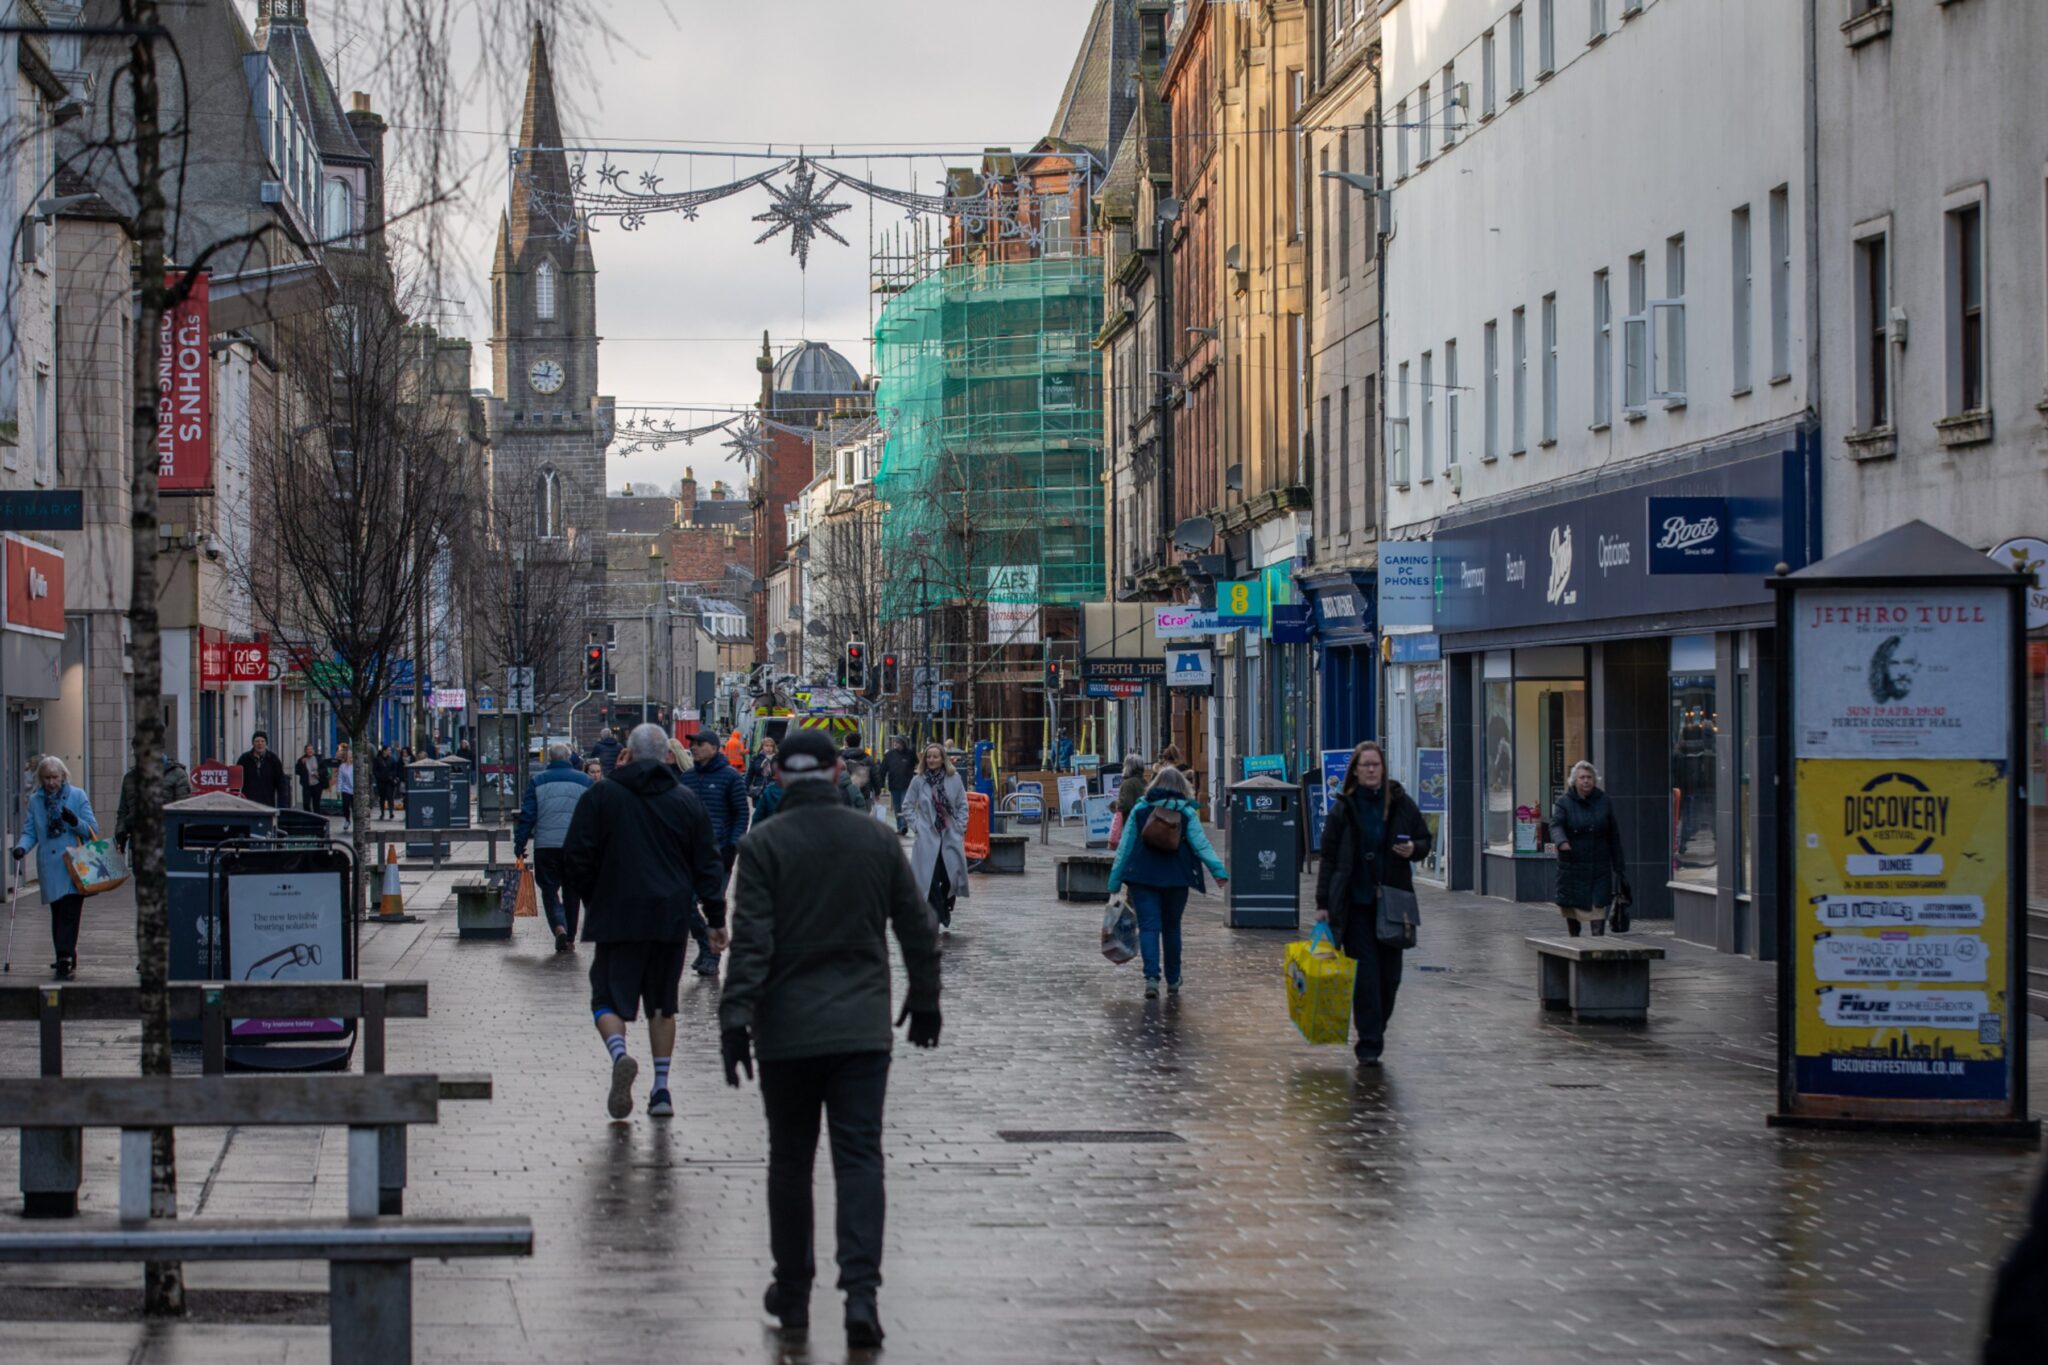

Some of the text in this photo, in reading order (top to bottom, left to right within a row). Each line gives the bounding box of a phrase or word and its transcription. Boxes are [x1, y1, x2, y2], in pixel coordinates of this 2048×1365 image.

[188, 315, 200, 333] ST
[179, 328, 202, 442] JOHN'S
[158, 398, 174, 477] CENTRE
[0, 504, 72, 516] RIMARK
[1656, 516, 1719, 550] Boots
[1384, 556, 1429, 565] GAMING
[1598, 534, 1630, 578] Opticians
[1398, 567, 1414, 576] PC
[1506, 552, 1526, 590] Beauty
[1385, 577, 1430, 586] PHONES
[1461, 561, 1486, 596] Pharmacy
[2031, 593, 2048, 610] SP
[1811, 606, 1985, 628] JETHRO TULL
[234, 663, 266, 674] NEY
[1091, 663, 1165, 674] PERTH THE
[1846, 706, 1871, 717] SUN
[1832, 718, 1963, 728] PERTH CONCERT HALL
[201, 776, 229, 785] SALE
[1844, 795, 1950, 836] DISCOVERY
[1873, 829, 1917, 841] FESTIVAL
[1878, 859, 1913, 871] DUNDEE
[1829, 904, 1846, 917] THE
[252, 912, 268, 922] The
[254, 922, 317, 932] hearing solution
[1826, 942, 1974, 956] TONY HADLEY LEVEL 42
[1857, 957, 1944, 969] MARC ALMOND
[261, 1021, 271, 1029] Try
[295, 1020, 314, 1028] today
[1831, 1058, 1965, 1075] DISCOVERYFESTIVAL.CO.UK
